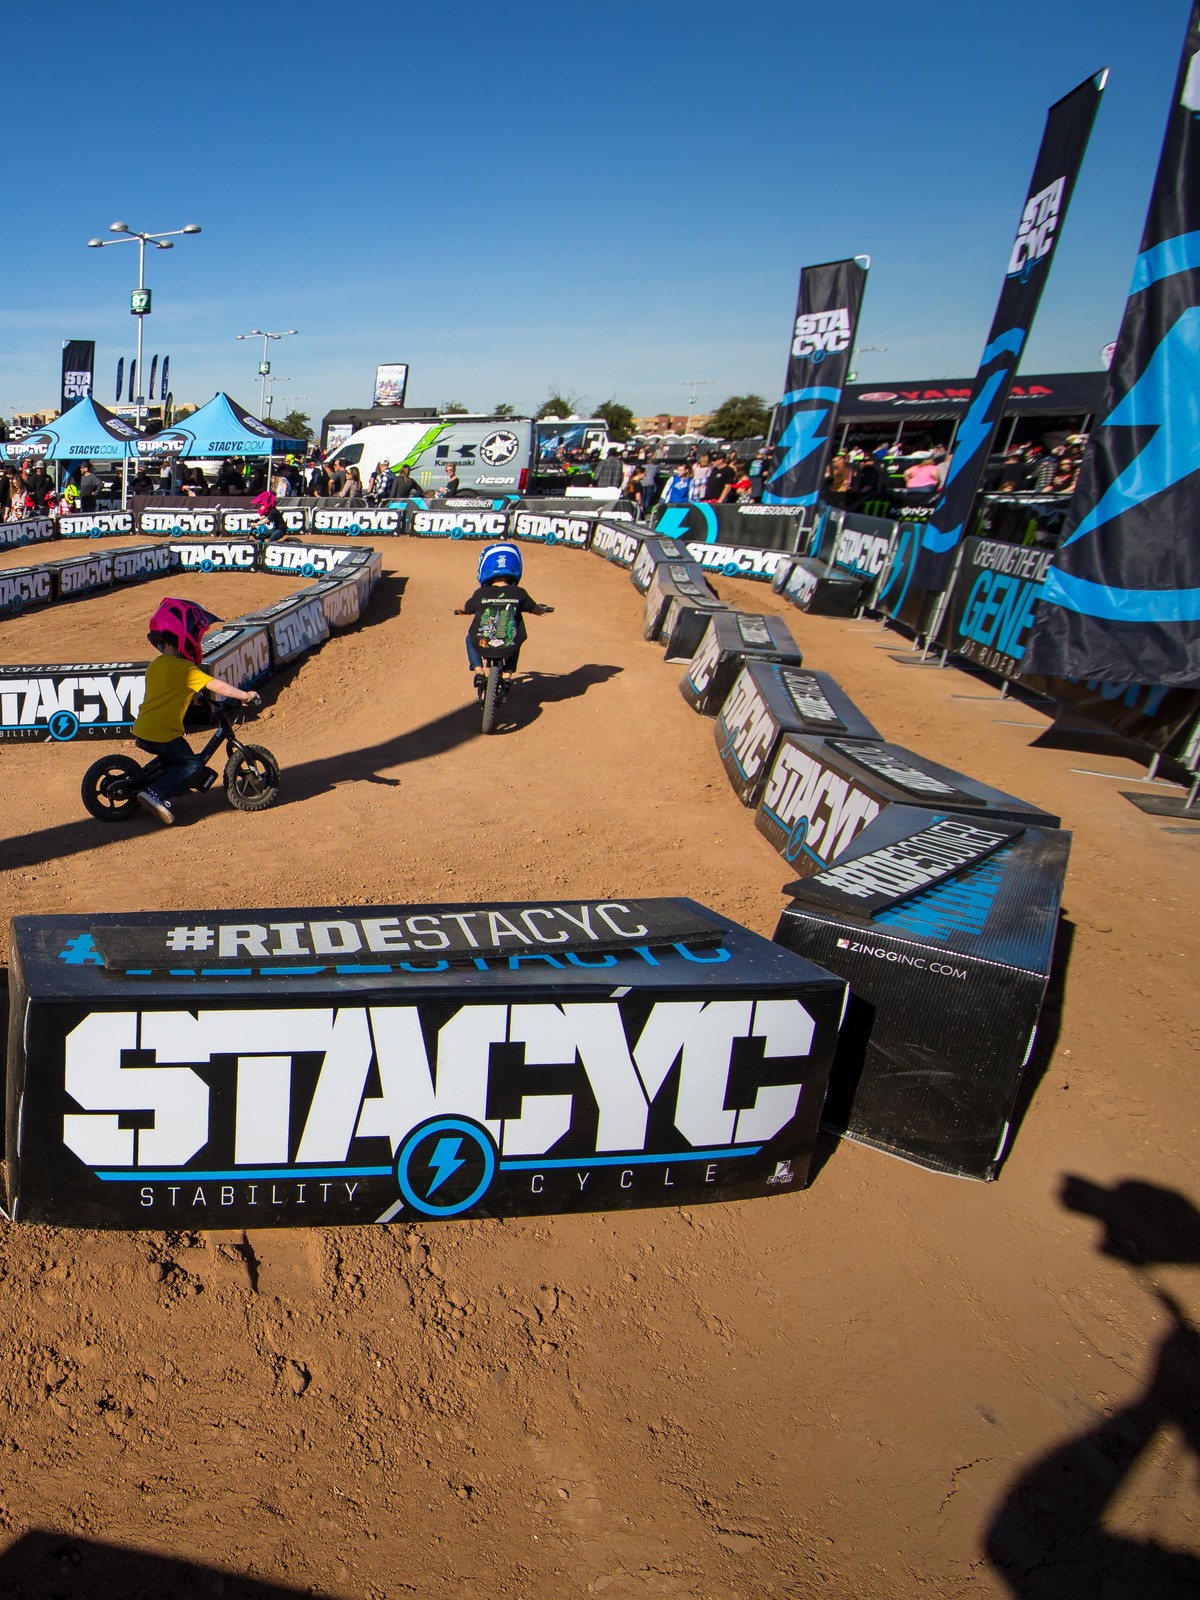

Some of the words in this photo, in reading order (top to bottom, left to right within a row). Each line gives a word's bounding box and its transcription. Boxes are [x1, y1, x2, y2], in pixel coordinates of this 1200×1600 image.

[1018, 176, 1066, 236] STA
[1007, 216, 1057, 275] CYC
[132, 295, 148, 307] 87
[796, 308, 849, 335] STA
[792, 329, 851, 357] CYC
[64, 371, 91, 385] STA
[898, 385, 1054, 400] YAMA
[6, 443, 48, 454] STACYC
[69, 445, 118, 454] STACYC.COM
[136, 440, 184, 450] STACYC
[208, 440, 265, 451] STACYC.COM
[59, 514, 132, 533] STACYC
[141, 513, 214, 532] STACYC
[314, 511, 399, 530] STACYC
[414, 513, 507, 534] STACYC
[738, 506, 802, 516] #RIDESOONER
[517, 514, 589, 543] STACYC
[593, 523, 638, 563] STACYC
[837, 529, 889, 575] STACYC
[114, 548, 170, 578] STACYC
[265, 546, 351, 571] STACY
[973, 540, 1018, 575] CREATING
[1012, 548, 1036, 579] THE
[1031, 552, 1055, 582] NE
[61, 559, 113, 592] STACYC
[274, 600, 327, 658] STACYC
[89, 727, 134, 735] CYCL
[722, 667, 775, 779] STACYC
[764, 742, 880, 862] STACYC
[812, 820, 1009, 898] #RIDESOONER
[166, 902, 648, 957] #RIDESTACYC
[851, 942, 967, 980] ZINGGINC.COM
[63, 999, 816, 1167] STACYC
[140, 1181, 359, 1207] STABILITY
[530, 1163, 717, 1195] CYCLE
